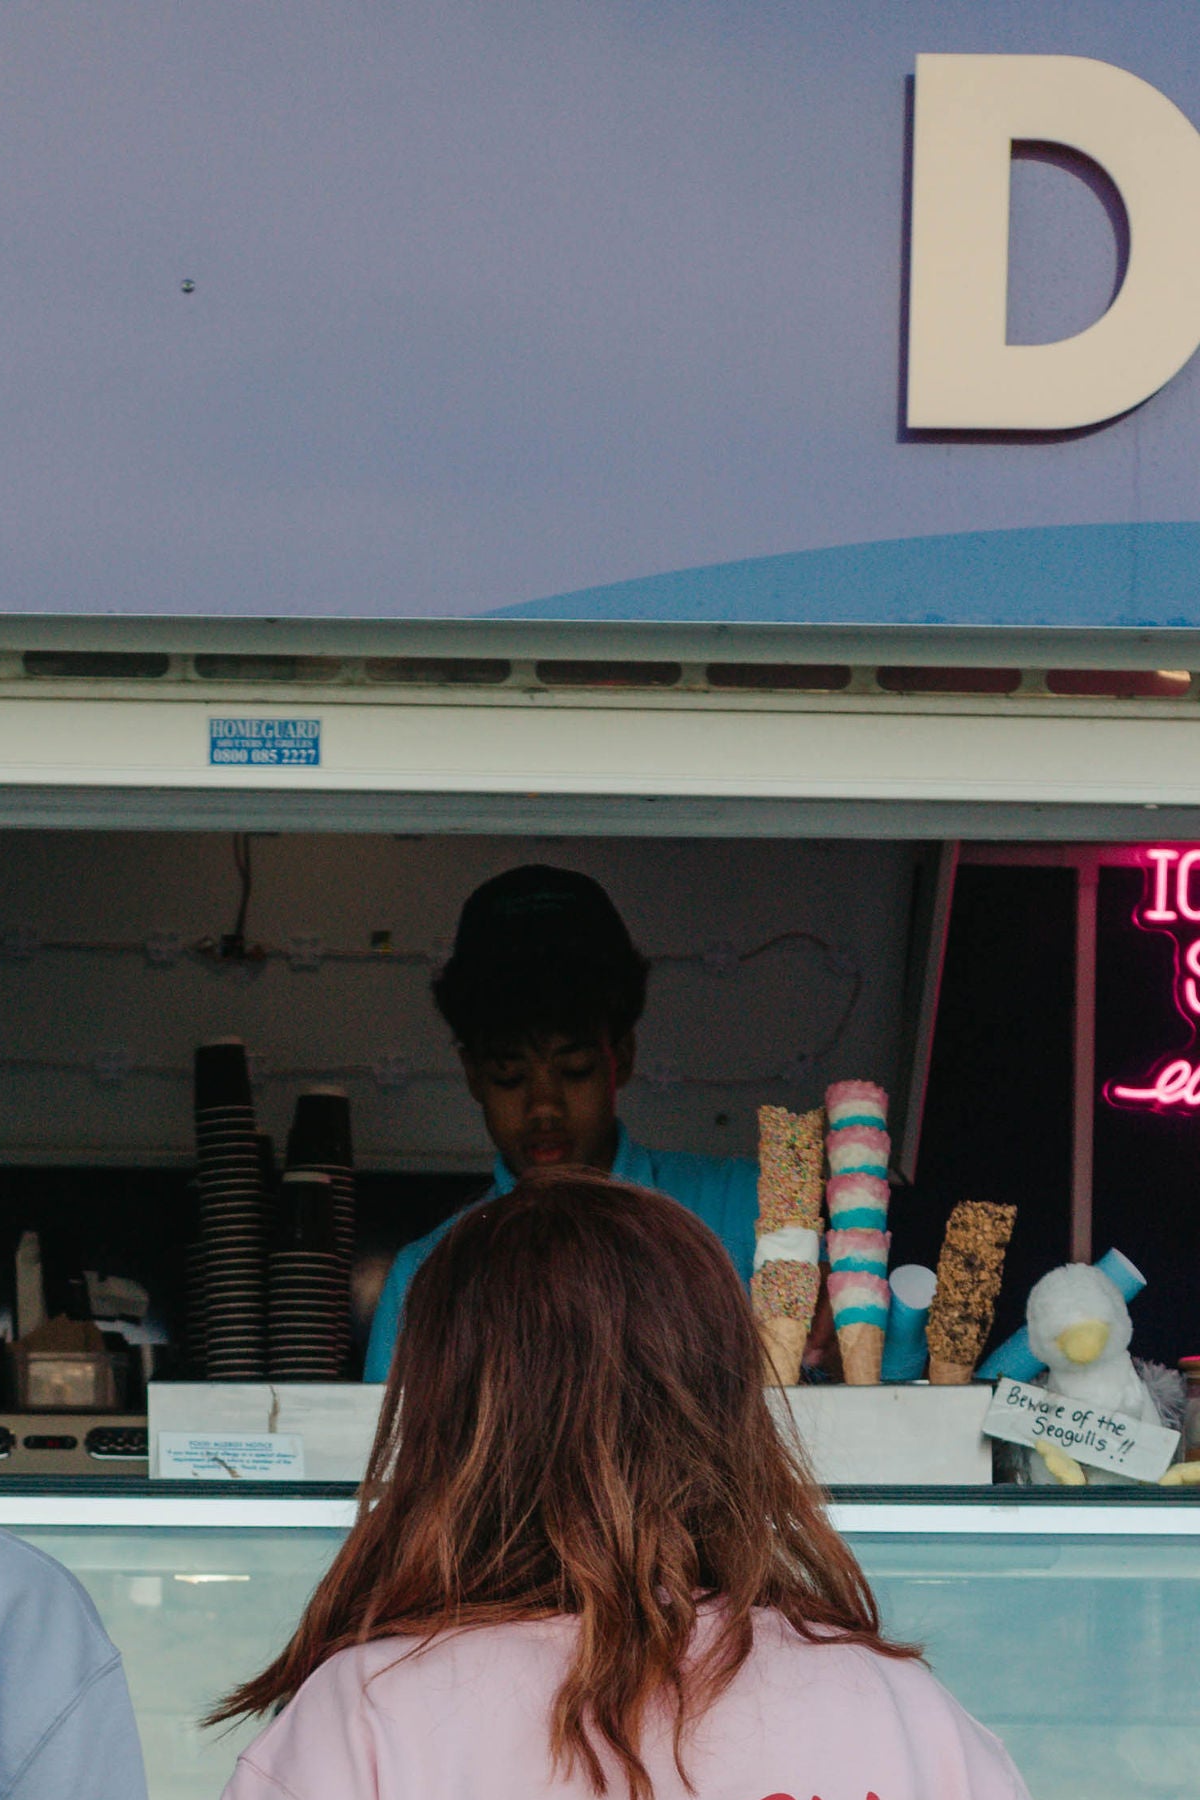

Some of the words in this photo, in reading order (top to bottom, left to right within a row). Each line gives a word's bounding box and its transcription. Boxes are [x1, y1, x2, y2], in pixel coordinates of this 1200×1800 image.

[906, 53, 1200, 432] D
[211, 719, 319, 738] HOMEGUARD
[213, 749, 248, 762] 0800
[282, 749, 315, 763] 2227
[1007, 1386, 1066, 1419] Beware
[1072, 1410, 1094, 1428] of
[1098, 1415, 1127, 1437] the
[1032, 1416, 1107, 1452] Seagulls
